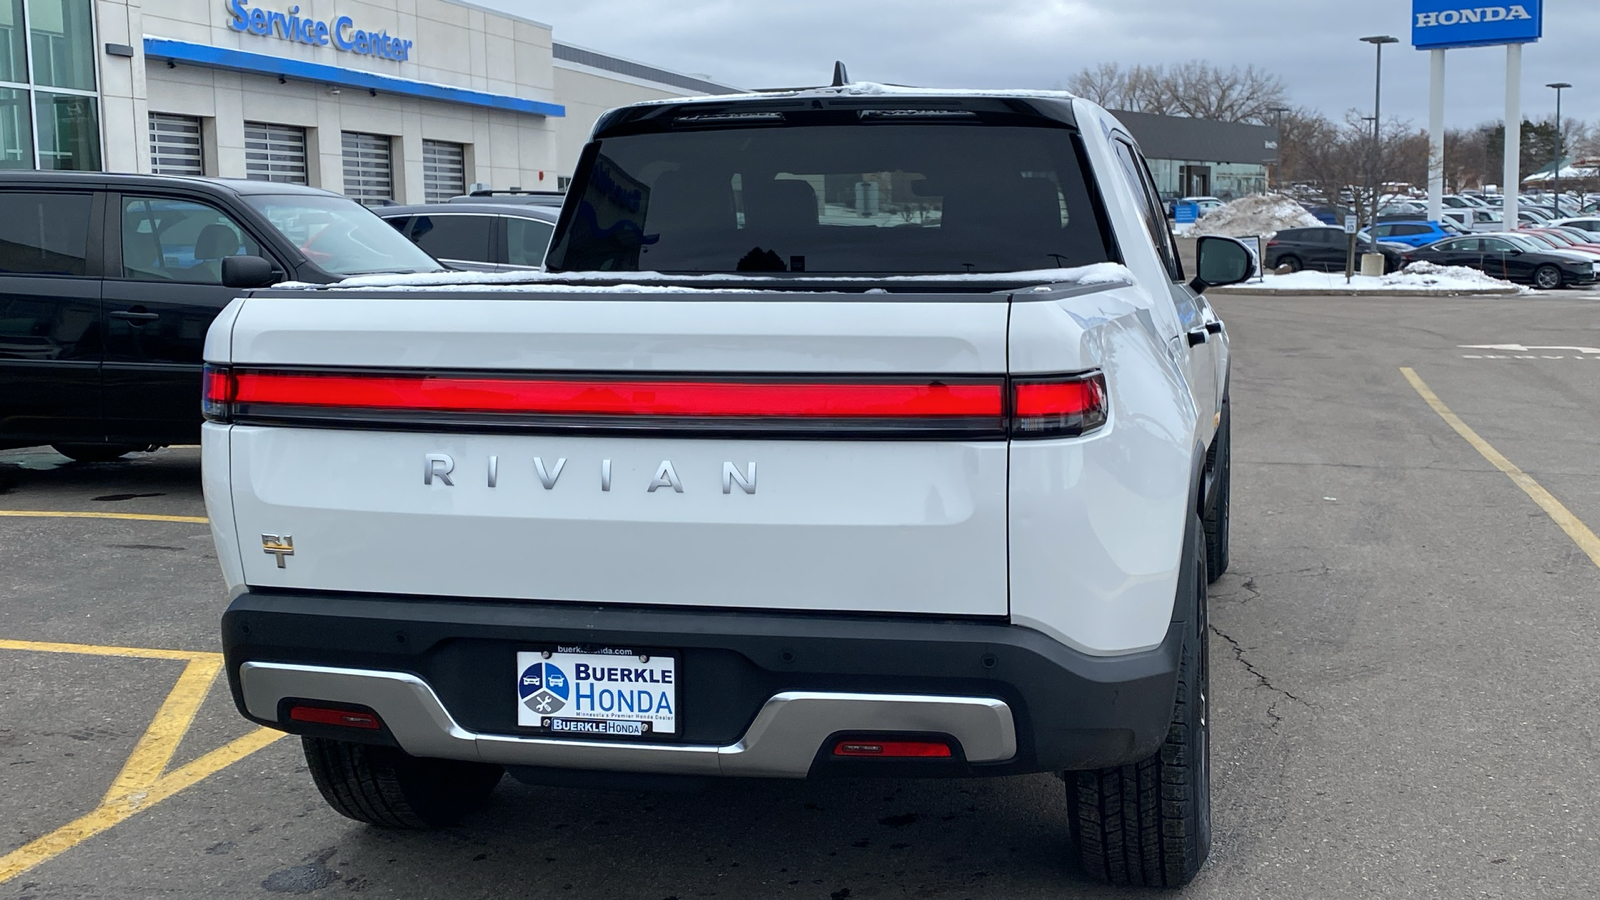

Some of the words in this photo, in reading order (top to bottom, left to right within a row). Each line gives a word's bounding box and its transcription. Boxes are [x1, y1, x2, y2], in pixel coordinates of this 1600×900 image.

[1415, 5, 1532, 27] HONDA
[226, 0, 329, 46] Service
[330, 15, 412, 62] Center
[424, 453, 757, 495] RIVIAN
[575, 663, 673, 684] BUERKLE
[575, 682, 673, 714] HONDA
[553, 719, 606, 732] BUERKLE
[608, 721, 640, 734] HONDA
